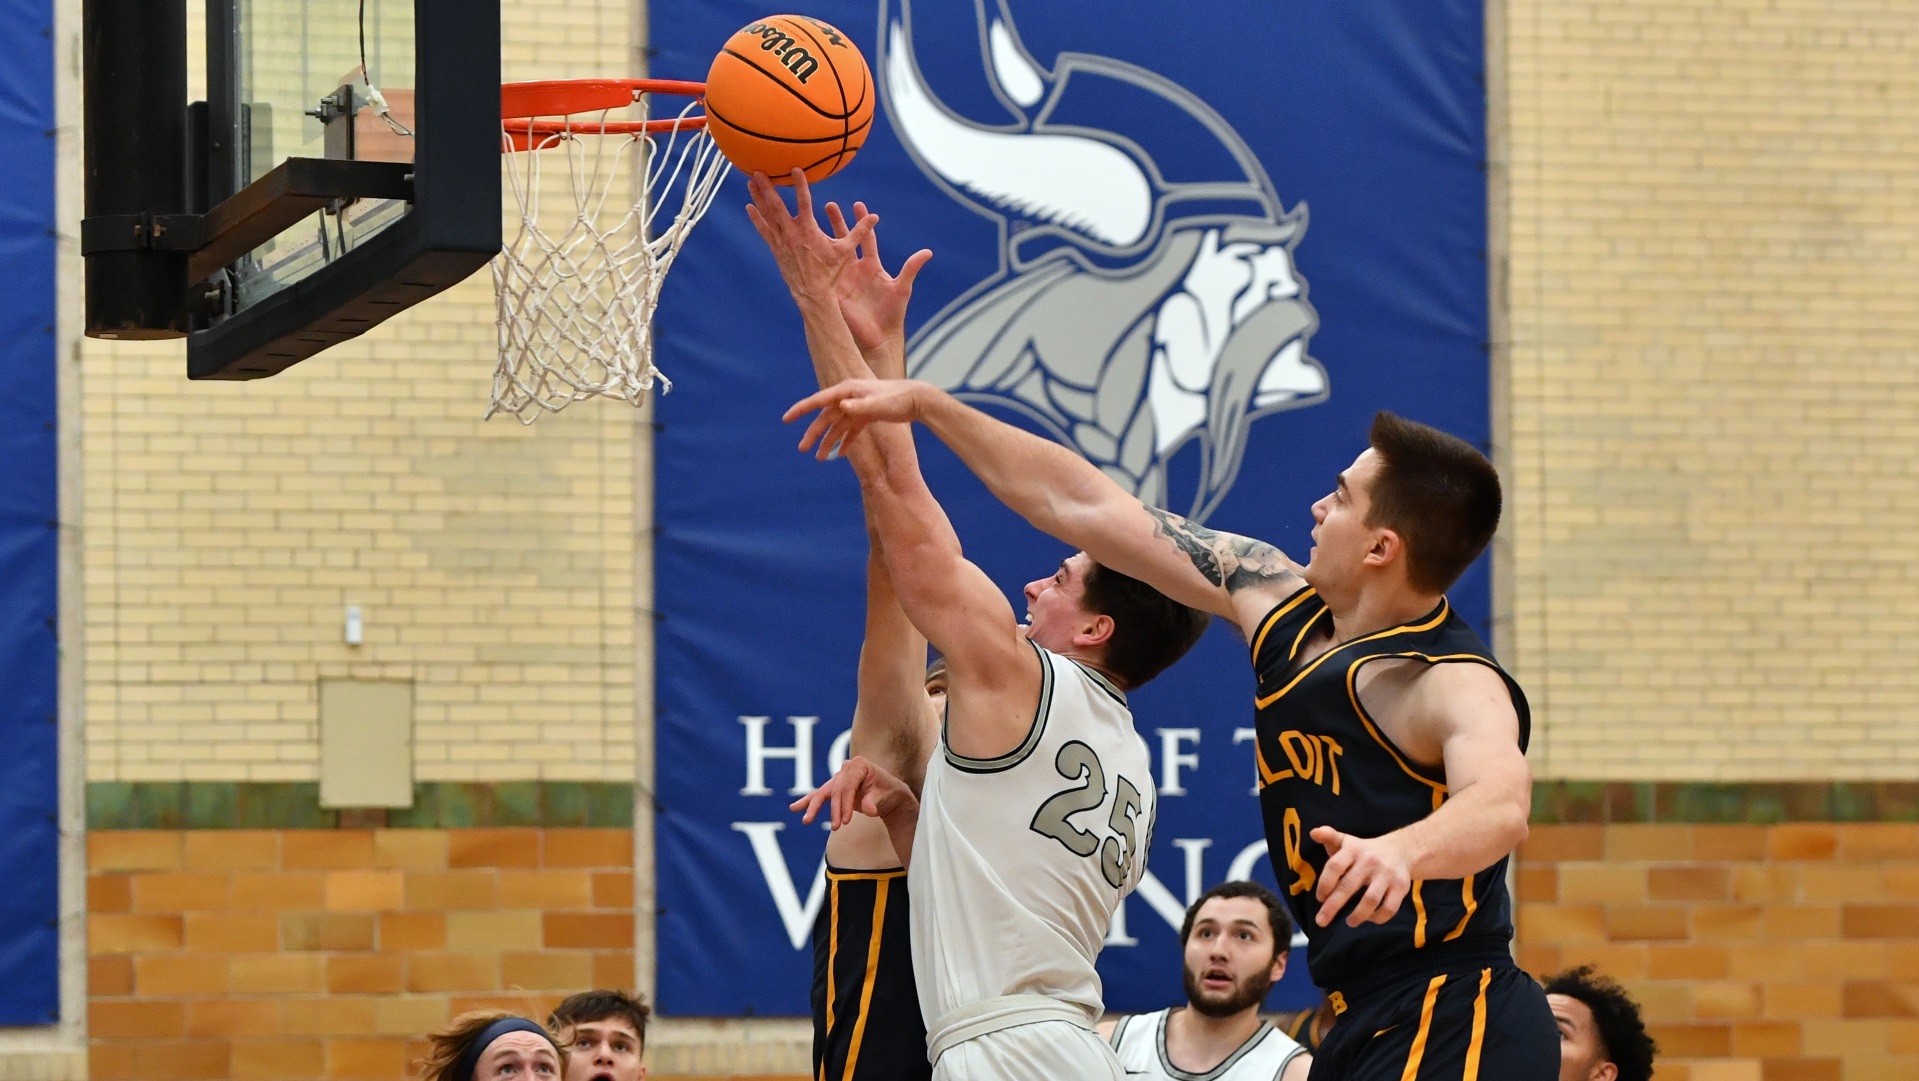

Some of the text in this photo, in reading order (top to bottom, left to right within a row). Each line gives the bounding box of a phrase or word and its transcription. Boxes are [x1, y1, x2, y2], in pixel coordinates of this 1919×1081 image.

[1143, 727, 1202, 797] F
[1255, 729, 1344, 796] LOIT
[1029, 739, 1143, 890] 25
